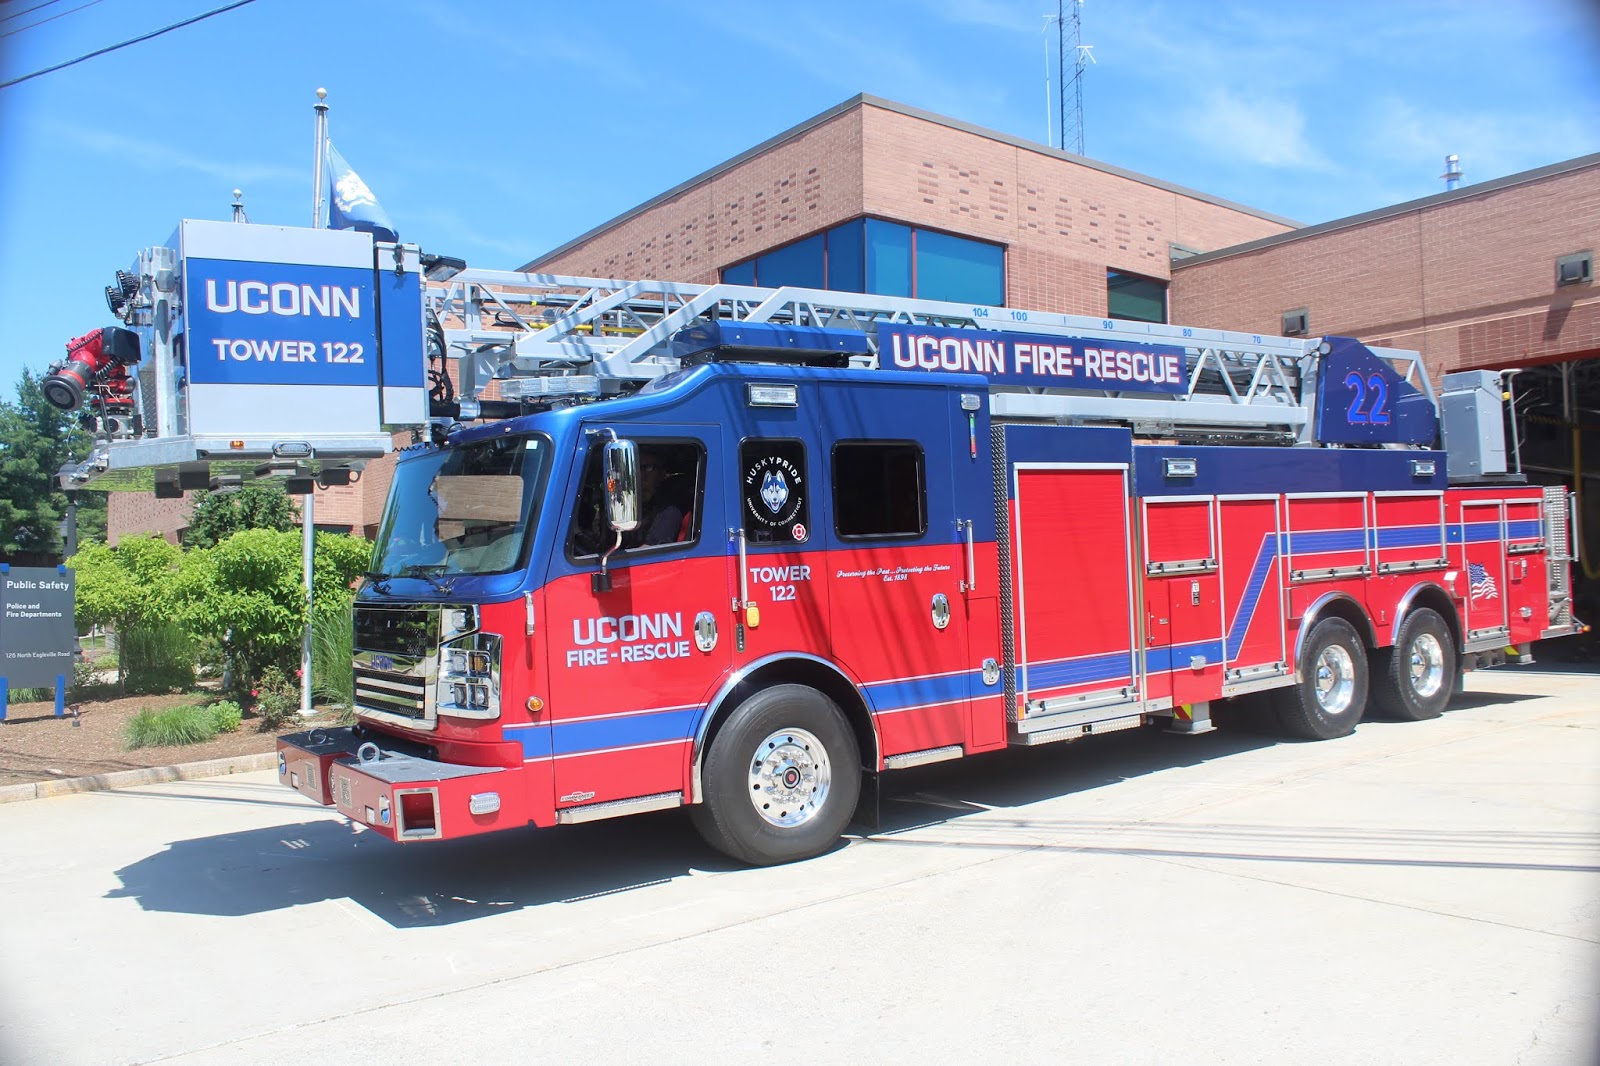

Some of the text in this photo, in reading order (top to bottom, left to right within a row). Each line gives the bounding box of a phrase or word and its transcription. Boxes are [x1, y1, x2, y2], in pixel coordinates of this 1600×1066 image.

[206, 279, 360, 318] UCONN
[972, 307, 989, 318] 104
[1010, 311, 1028, 322] 100
[1102, 320, 1113, 330] 90
[1182, 328, 1192, 337] 80
[1252, 335, 1261, 344] 70
[212, 338, 365, 364] TOWER 122
[892, 333, 1183, 385] UCONN FIRE-RESCUE
[1345, 371, 1390, 424] 22
[747, 497, 768, 524] UNIVERSITY
[777, 497, 803, 526] CONNECTICUT
[750, 565, 811, 583] TOWER
[836, 570, 867, 578] Preserving
[933, 563, 951, 571] Future
[6, 580, 70, 591] Public Safety
[769, 585, 796, 601] 122
[6, 602, 27, 610] Police
[573, 612, 683, 645] UCONN
